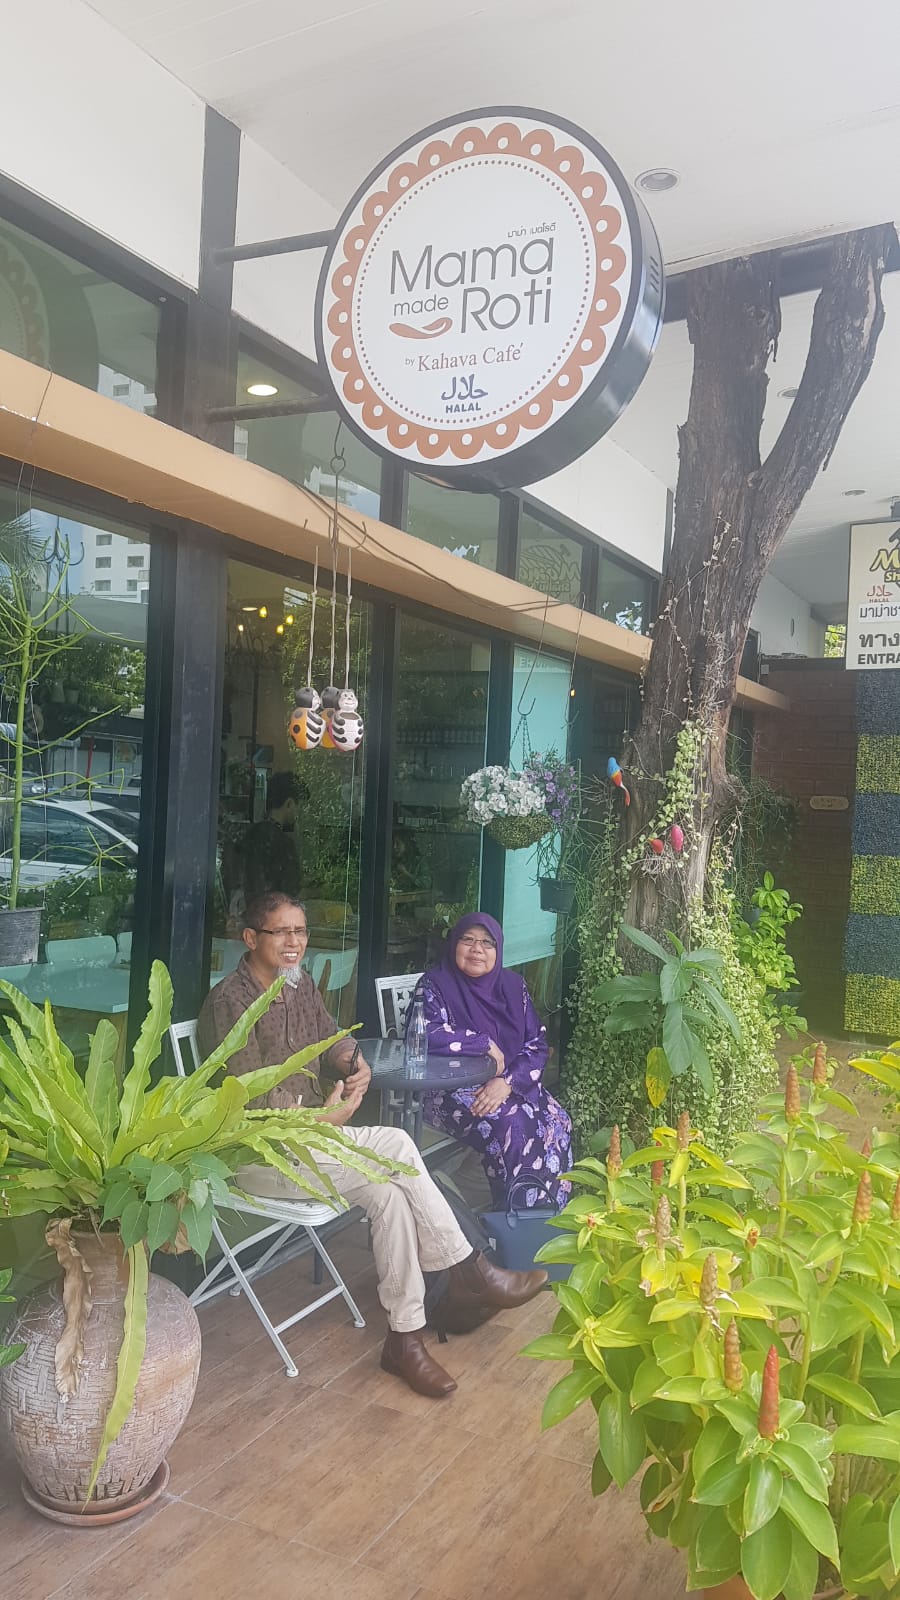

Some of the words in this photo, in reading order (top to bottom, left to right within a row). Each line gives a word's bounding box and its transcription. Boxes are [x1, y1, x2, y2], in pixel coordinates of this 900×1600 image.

[390, 237, 554, 294] Mama
[393, 293, 449, 317] made
[461, 276, 552, 334] Roti
[405, 358, 415, 367] by
[417, 352, 477, 372] Kahava
[441, 373, 488, 401] حلال
[445, 402, 481, 414] HALAL
[859, 633, 900, 648] ทาง
